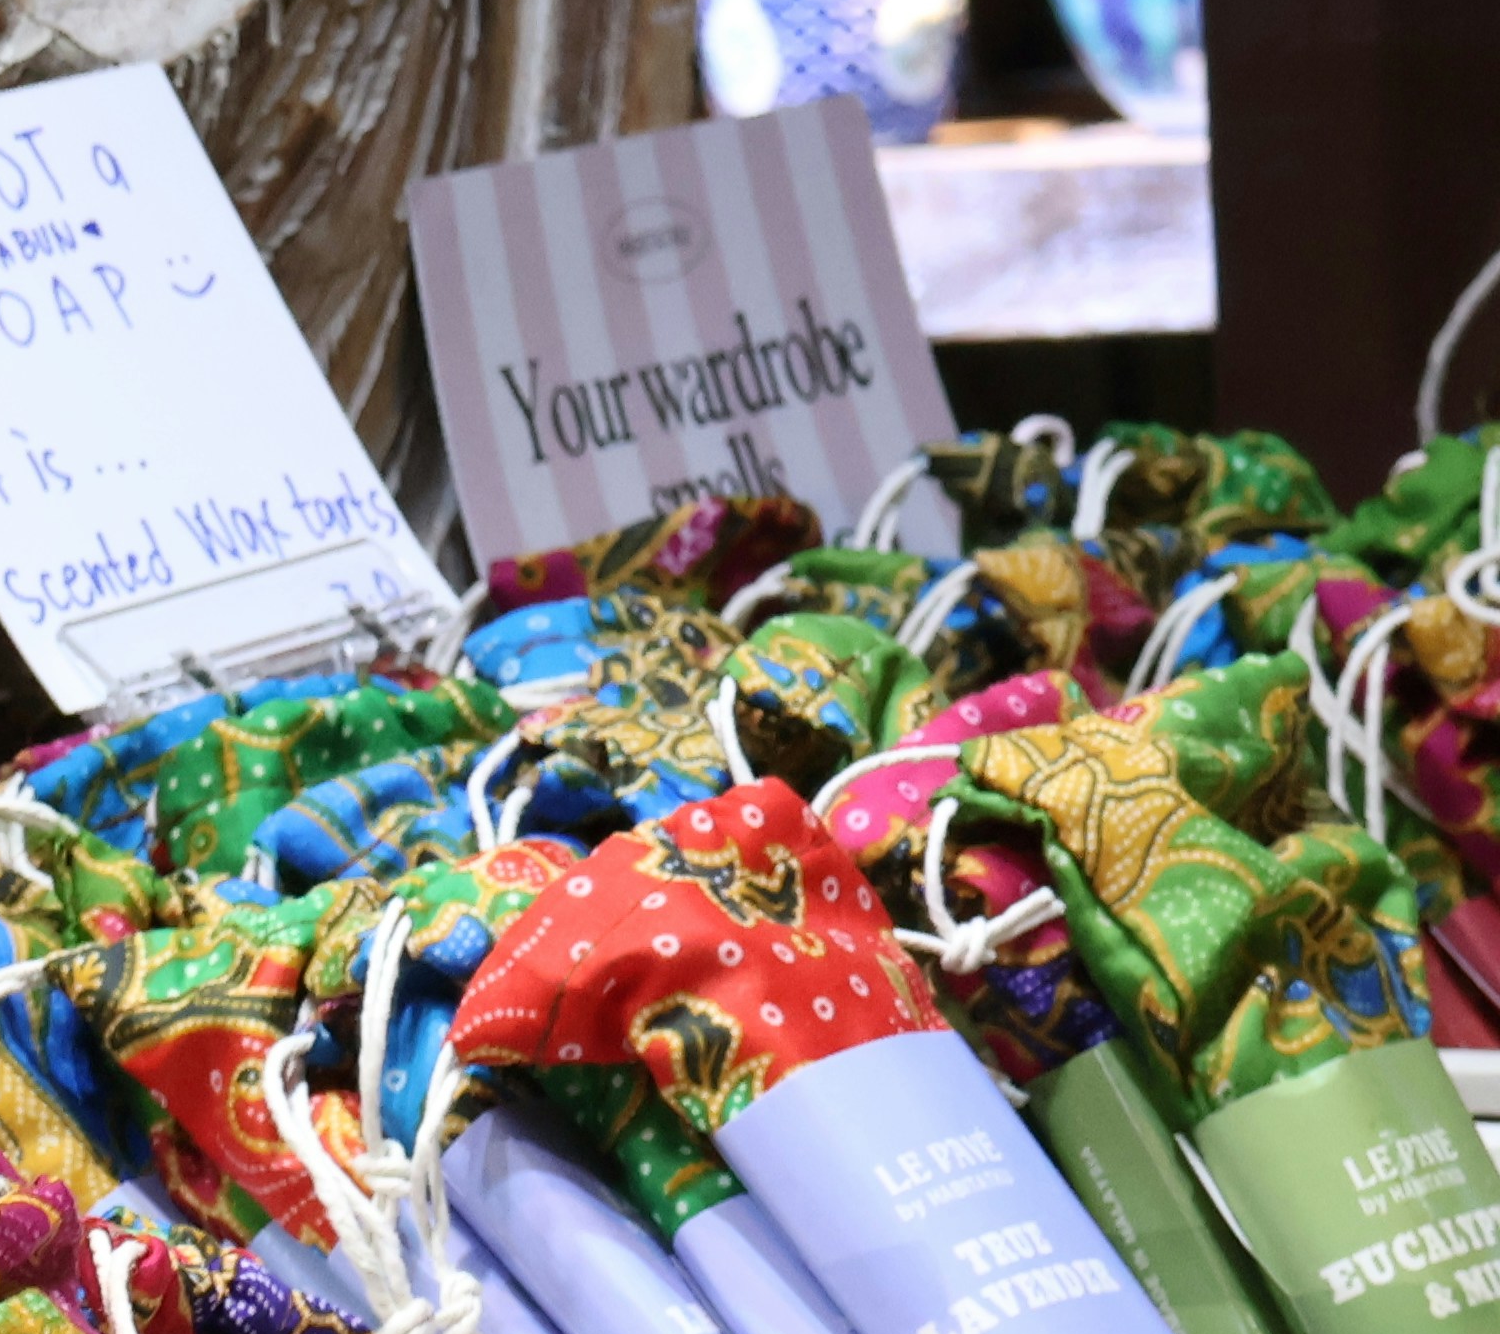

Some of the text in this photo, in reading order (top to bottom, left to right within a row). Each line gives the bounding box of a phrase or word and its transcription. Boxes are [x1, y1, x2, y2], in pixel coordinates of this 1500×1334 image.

[91, 143, 131, 193] a
[499, 296, 874, 464] Your wardrobe
[283, 471, 398, 539] tarts
[874, 1150, 933, 1196] LE
[953, 1220, 1053, 1276] TRUE
[1424, 1281, 1462, 1320] &
